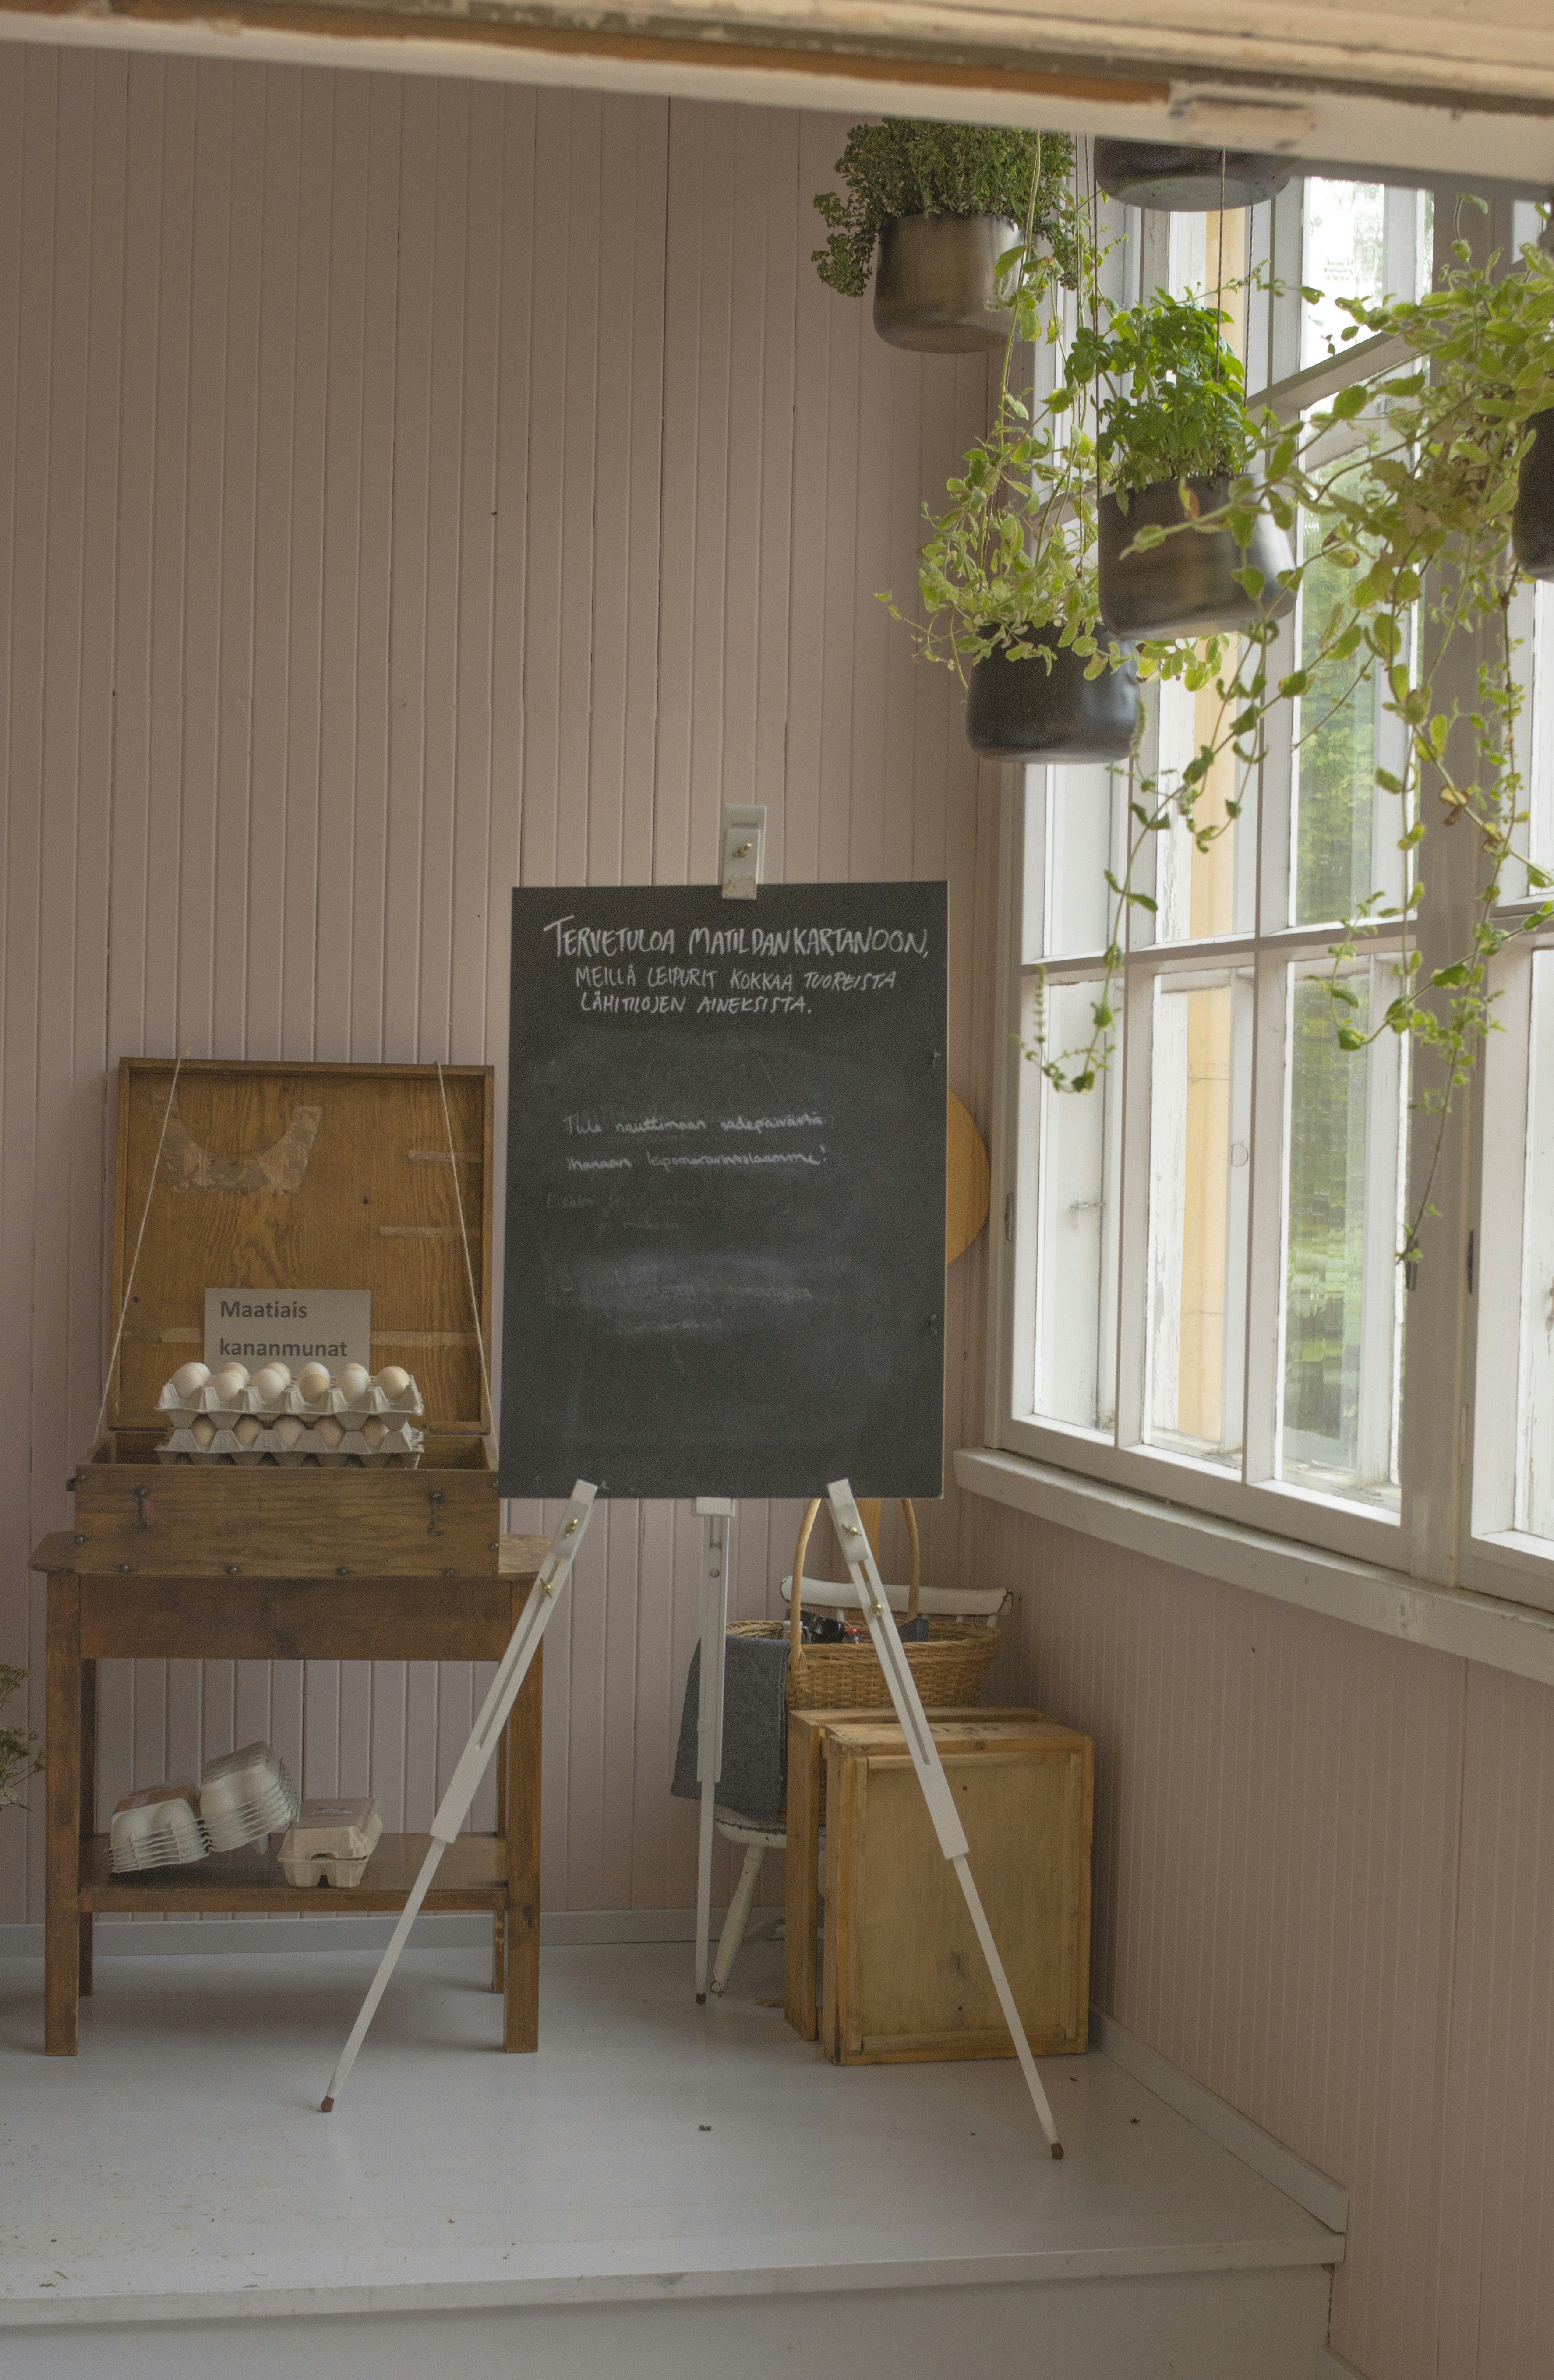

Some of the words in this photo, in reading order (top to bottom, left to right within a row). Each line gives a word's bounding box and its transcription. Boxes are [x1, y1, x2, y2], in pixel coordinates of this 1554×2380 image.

[543, 915, 675, 957] TERVETULOA
[576, 964, 636, 988] MEILLÄ
[647, 966, 717, 989] LEIPURIT
[730, 968, 793, 992] KOKKAA
[804, 971, 896, 991] TUOREISTA
[580, 990, 686, 1014] LÄHITILOJEN
[696, 996, 812, 1014] AINEKSISTA.
[563, 1115, 602, 1134] Tule
[221, 1300, 307, 1318] Maatiais
[219, 1338, 347, 1357] kananmunat
